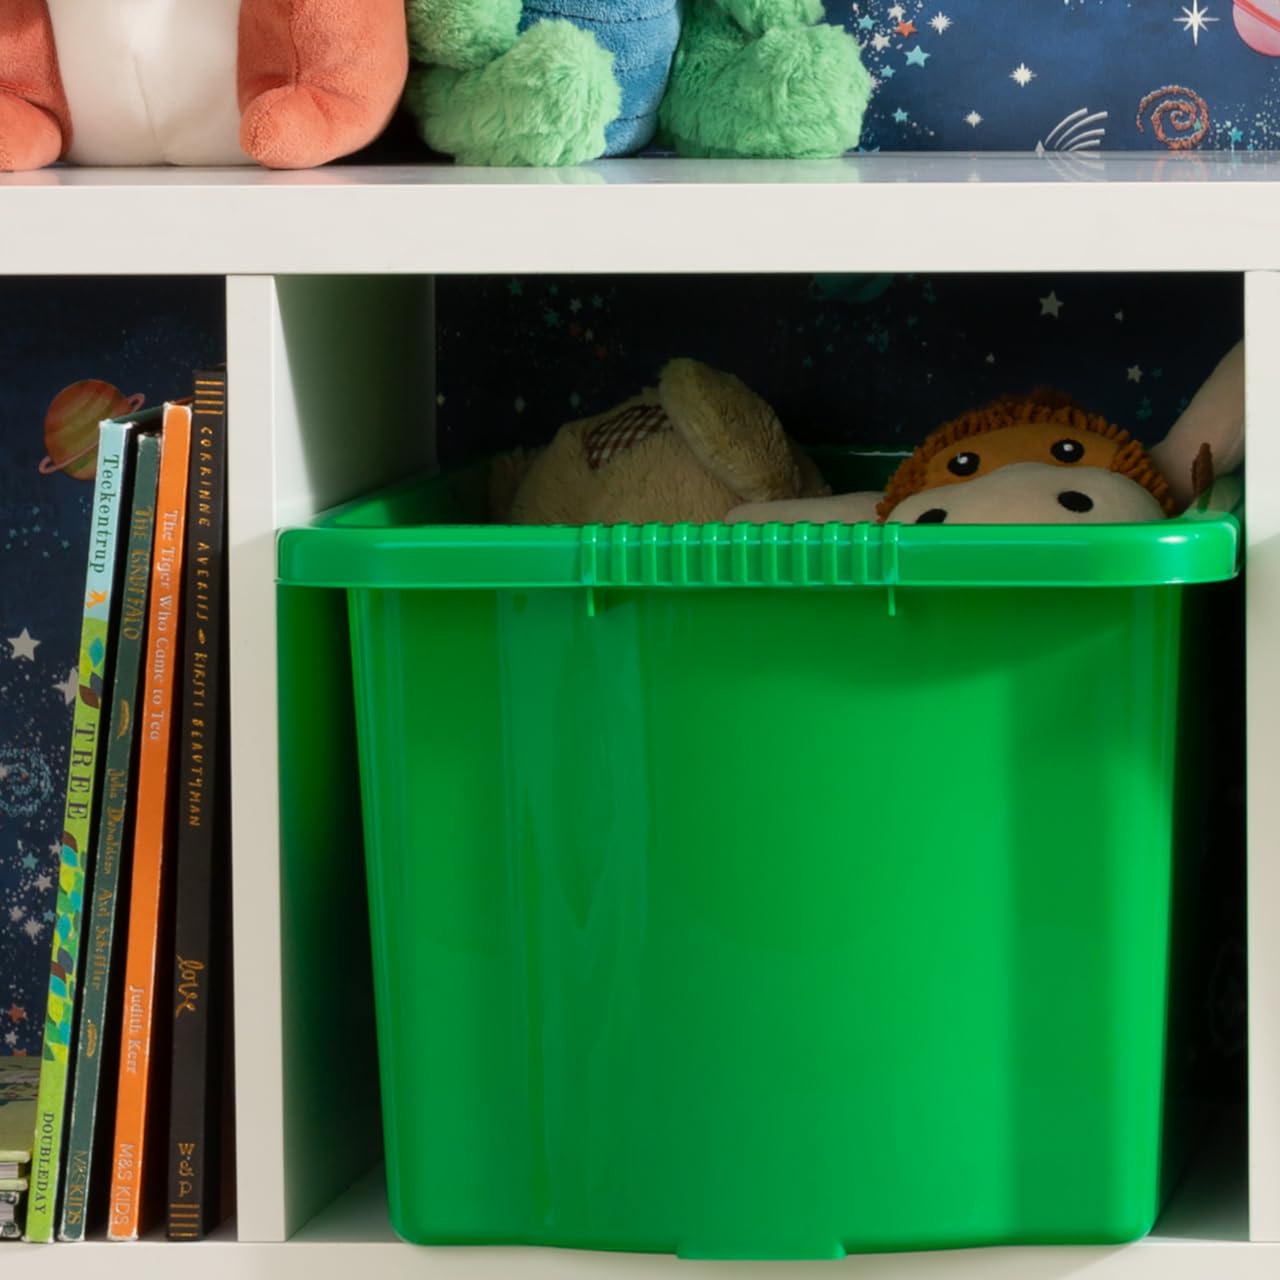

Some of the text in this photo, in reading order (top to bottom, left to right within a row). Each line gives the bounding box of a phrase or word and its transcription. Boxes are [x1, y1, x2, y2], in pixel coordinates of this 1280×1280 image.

[88, 454, 120, 574] Teckentrup
[133, 507, 153, 540] THE
[198, 426, 213, 527] CORRINNE
[149, 510, 178, 742] The Tiger Who Came to Tea
[67, 722, 96, 820] TREE
[187, 652, 208, 827] KIRSTI BEAUTYMAN
[127, 985, 145, 1074] Judith Kerr
[35, 1113, 54, 1215] DOUBLEDAY
[66, 1184, 85, 1225] KIDS
[113, 1143, 135, 1226] M&S KIDS
